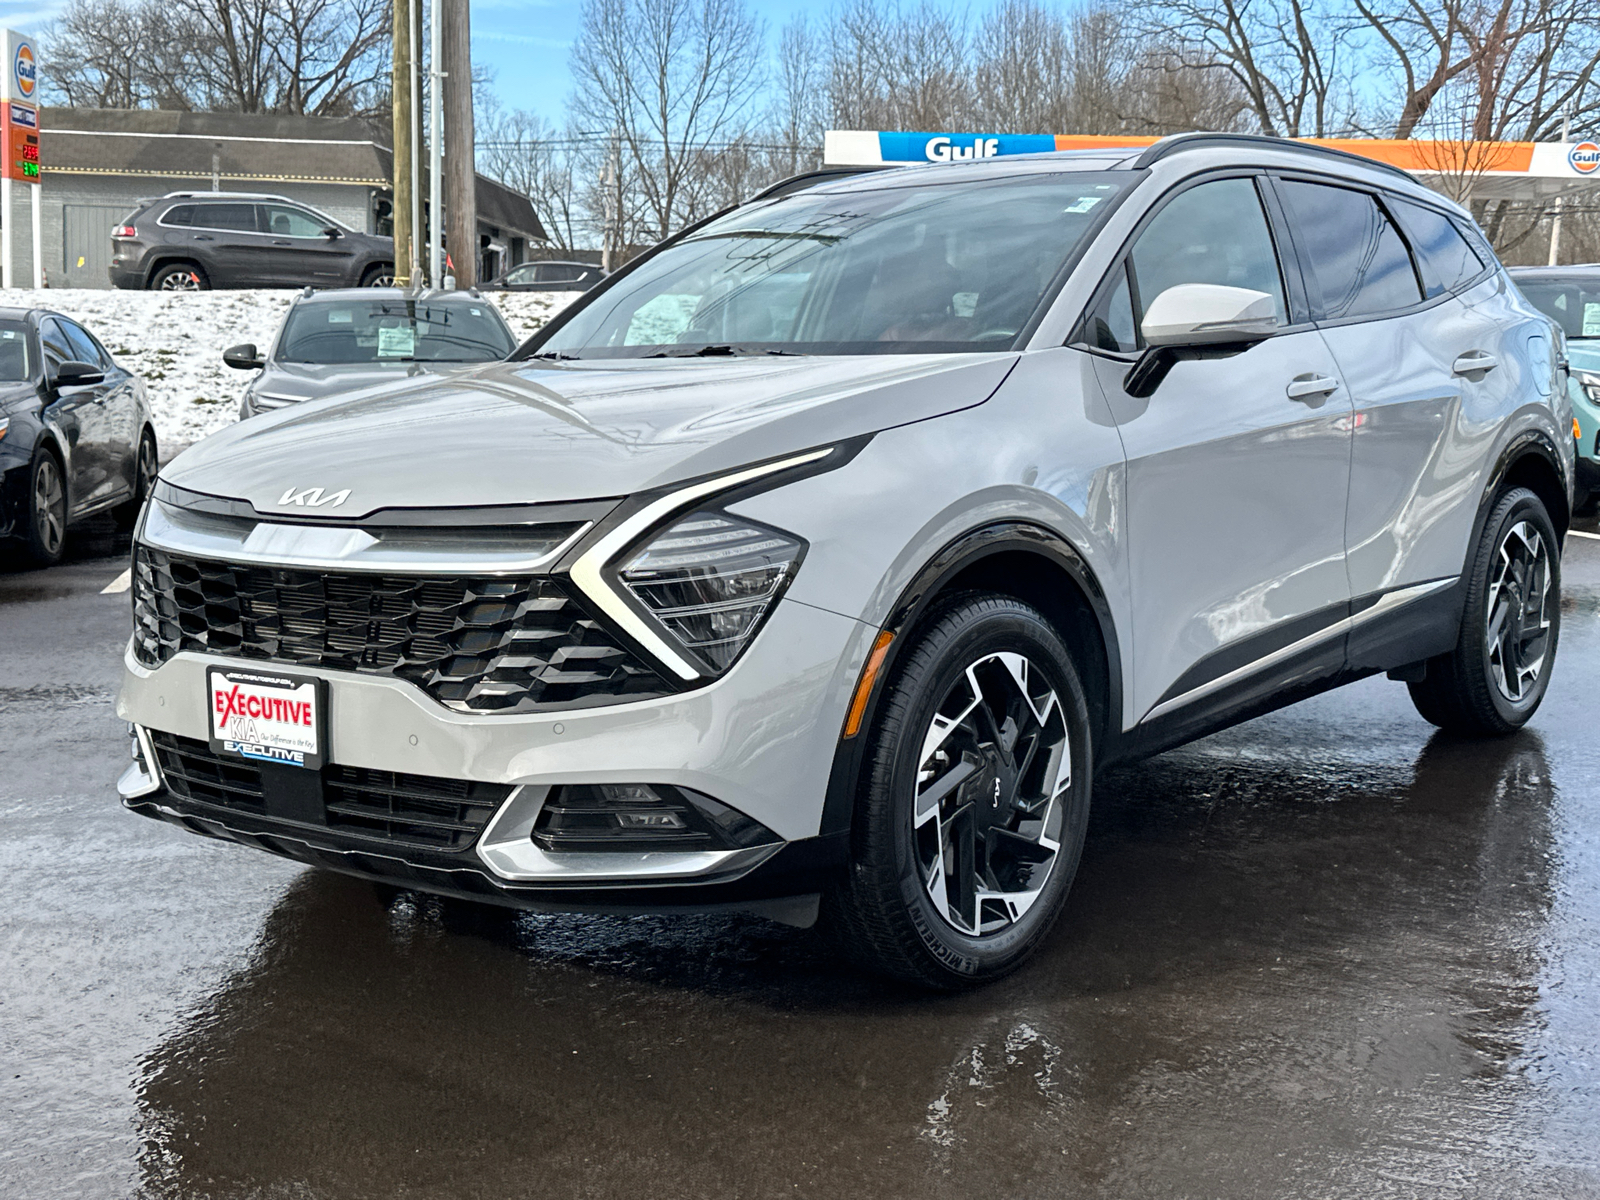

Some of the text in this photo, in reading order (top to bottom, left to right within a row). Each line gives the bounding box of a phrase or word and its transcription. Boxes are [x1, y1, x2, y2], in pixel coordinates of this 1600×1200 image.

[18, 60, 35, 80] Gulf
[925, 136, 999, 163] Gulf
[215, 684, 312, 728] EXECUTIVE
[229, 716, 260, 743] KIA
[223, 740, 304, 763] EXECUTIVE
[908, 907, 963, 970] MICHELIN
